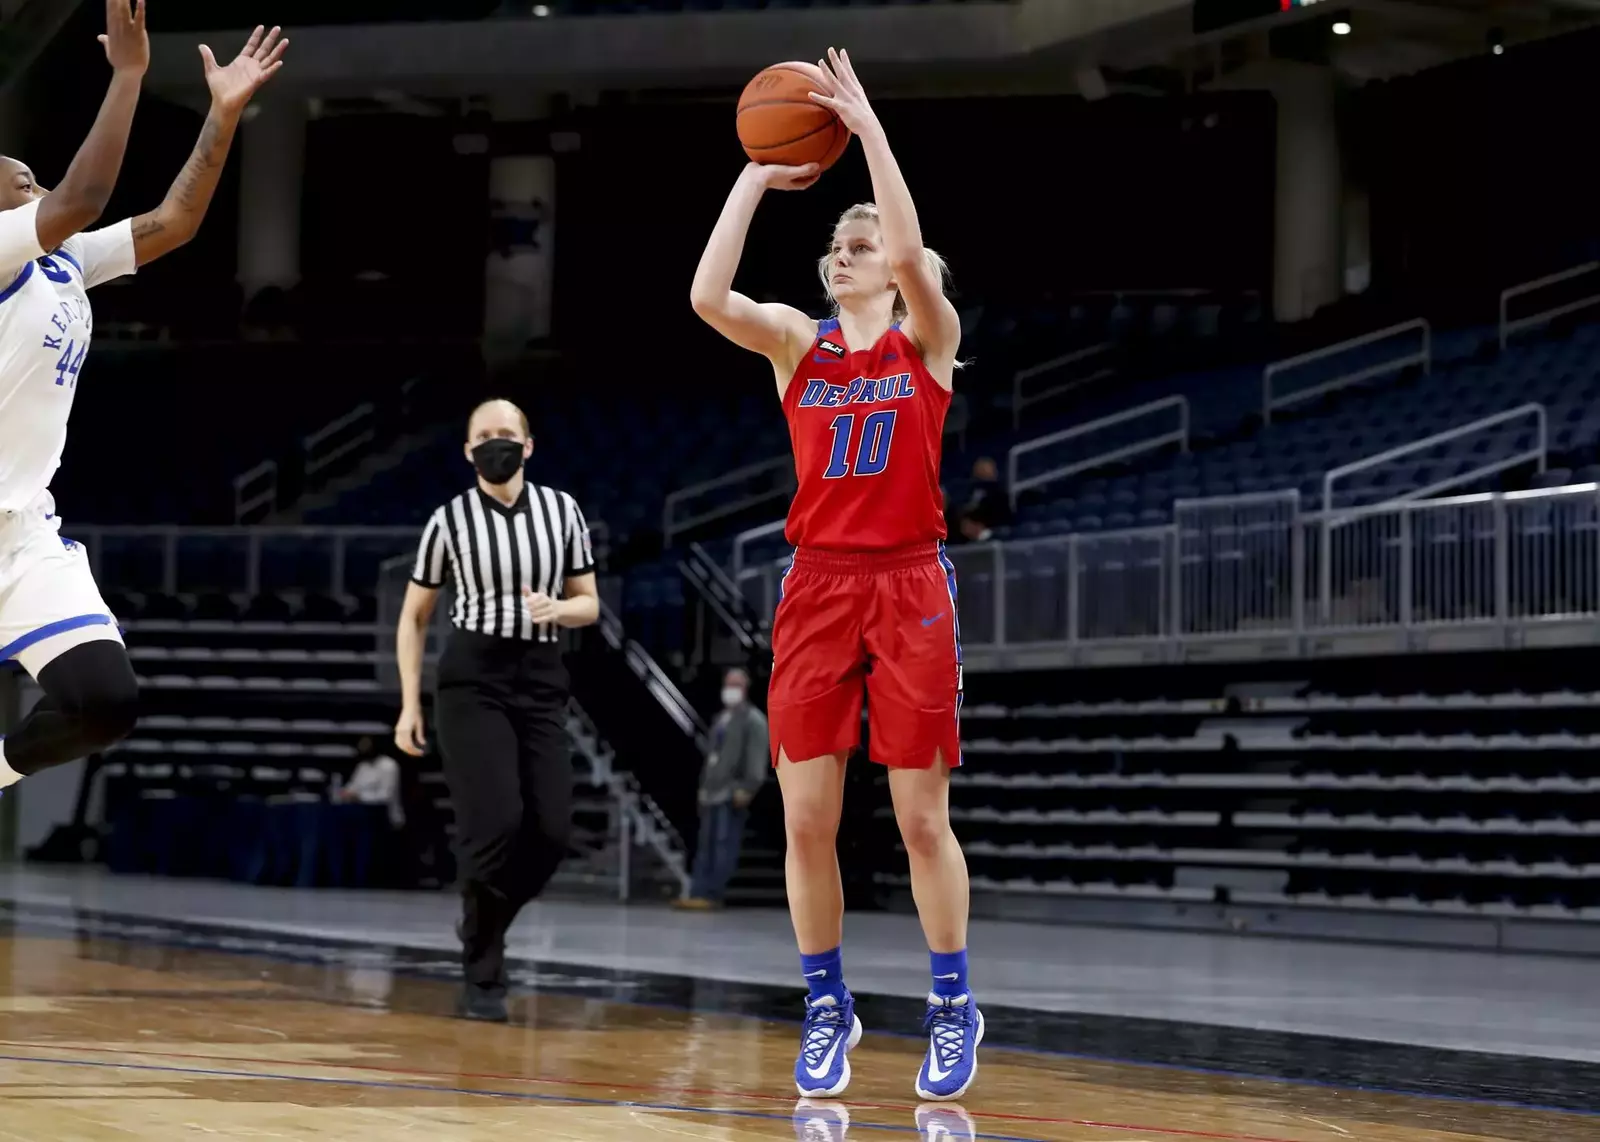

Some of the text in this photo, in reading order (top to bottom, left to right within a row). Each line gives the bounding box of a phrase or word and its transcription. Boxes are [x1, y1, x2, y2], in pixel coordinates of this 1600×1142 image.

[43, 296, 91, 351] KENT
[55, 338, 87, 389] 44
[798, 373, 915, 408] DEPAUL
[822, 409, 898, 479] 10
